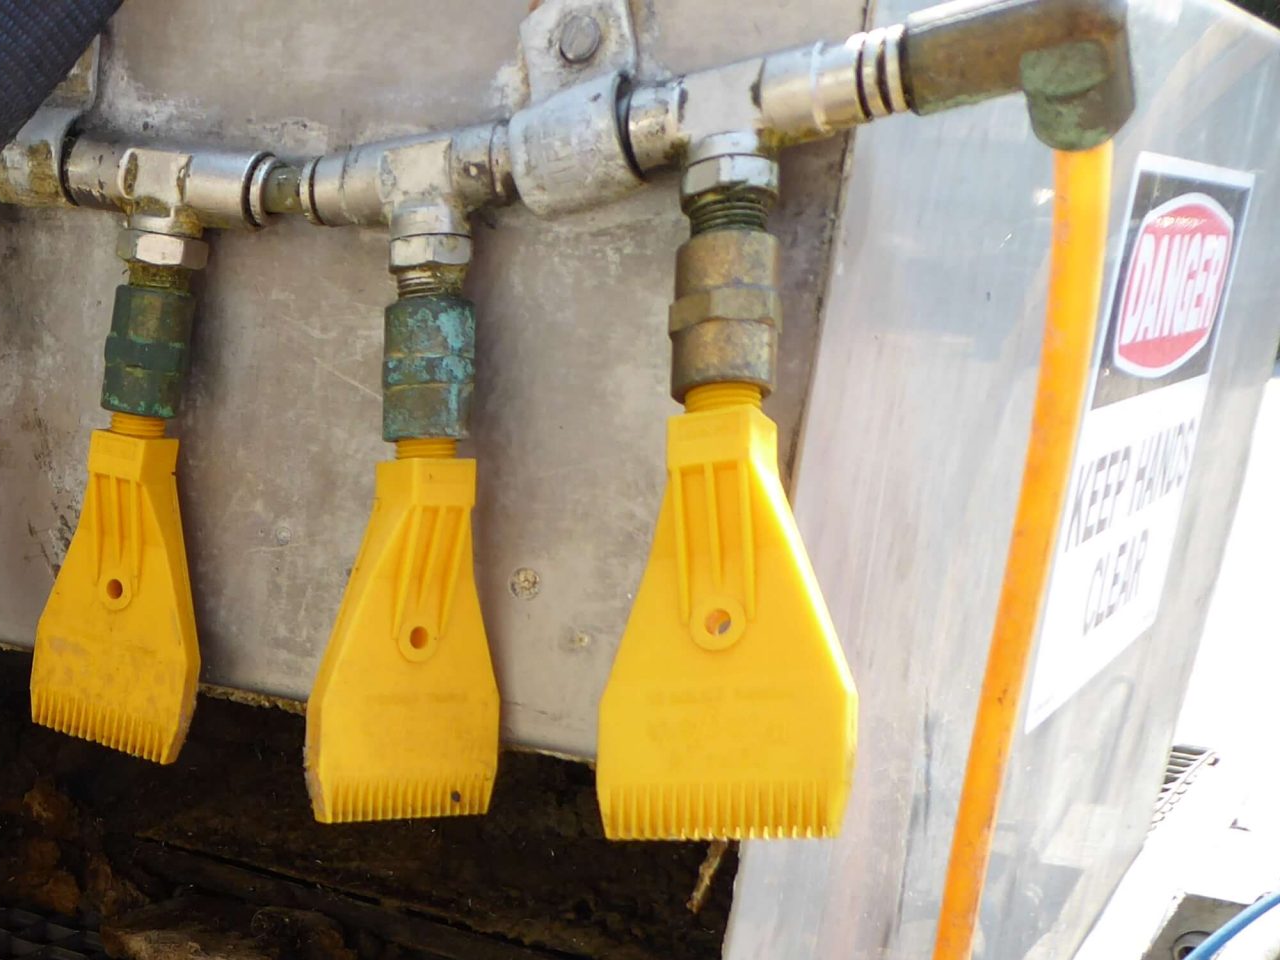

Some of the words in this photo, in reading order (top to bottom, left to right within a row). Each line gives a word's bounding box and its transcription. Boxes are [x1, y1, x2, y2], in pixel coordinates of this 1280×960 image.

[1121, 233, 1227, 347] DANGER
[1064, 445, 1132, 553] KEEP
[1126, 416, 1197, 516] HANDS
[1082, 528, 1150, 637] CLEAR
